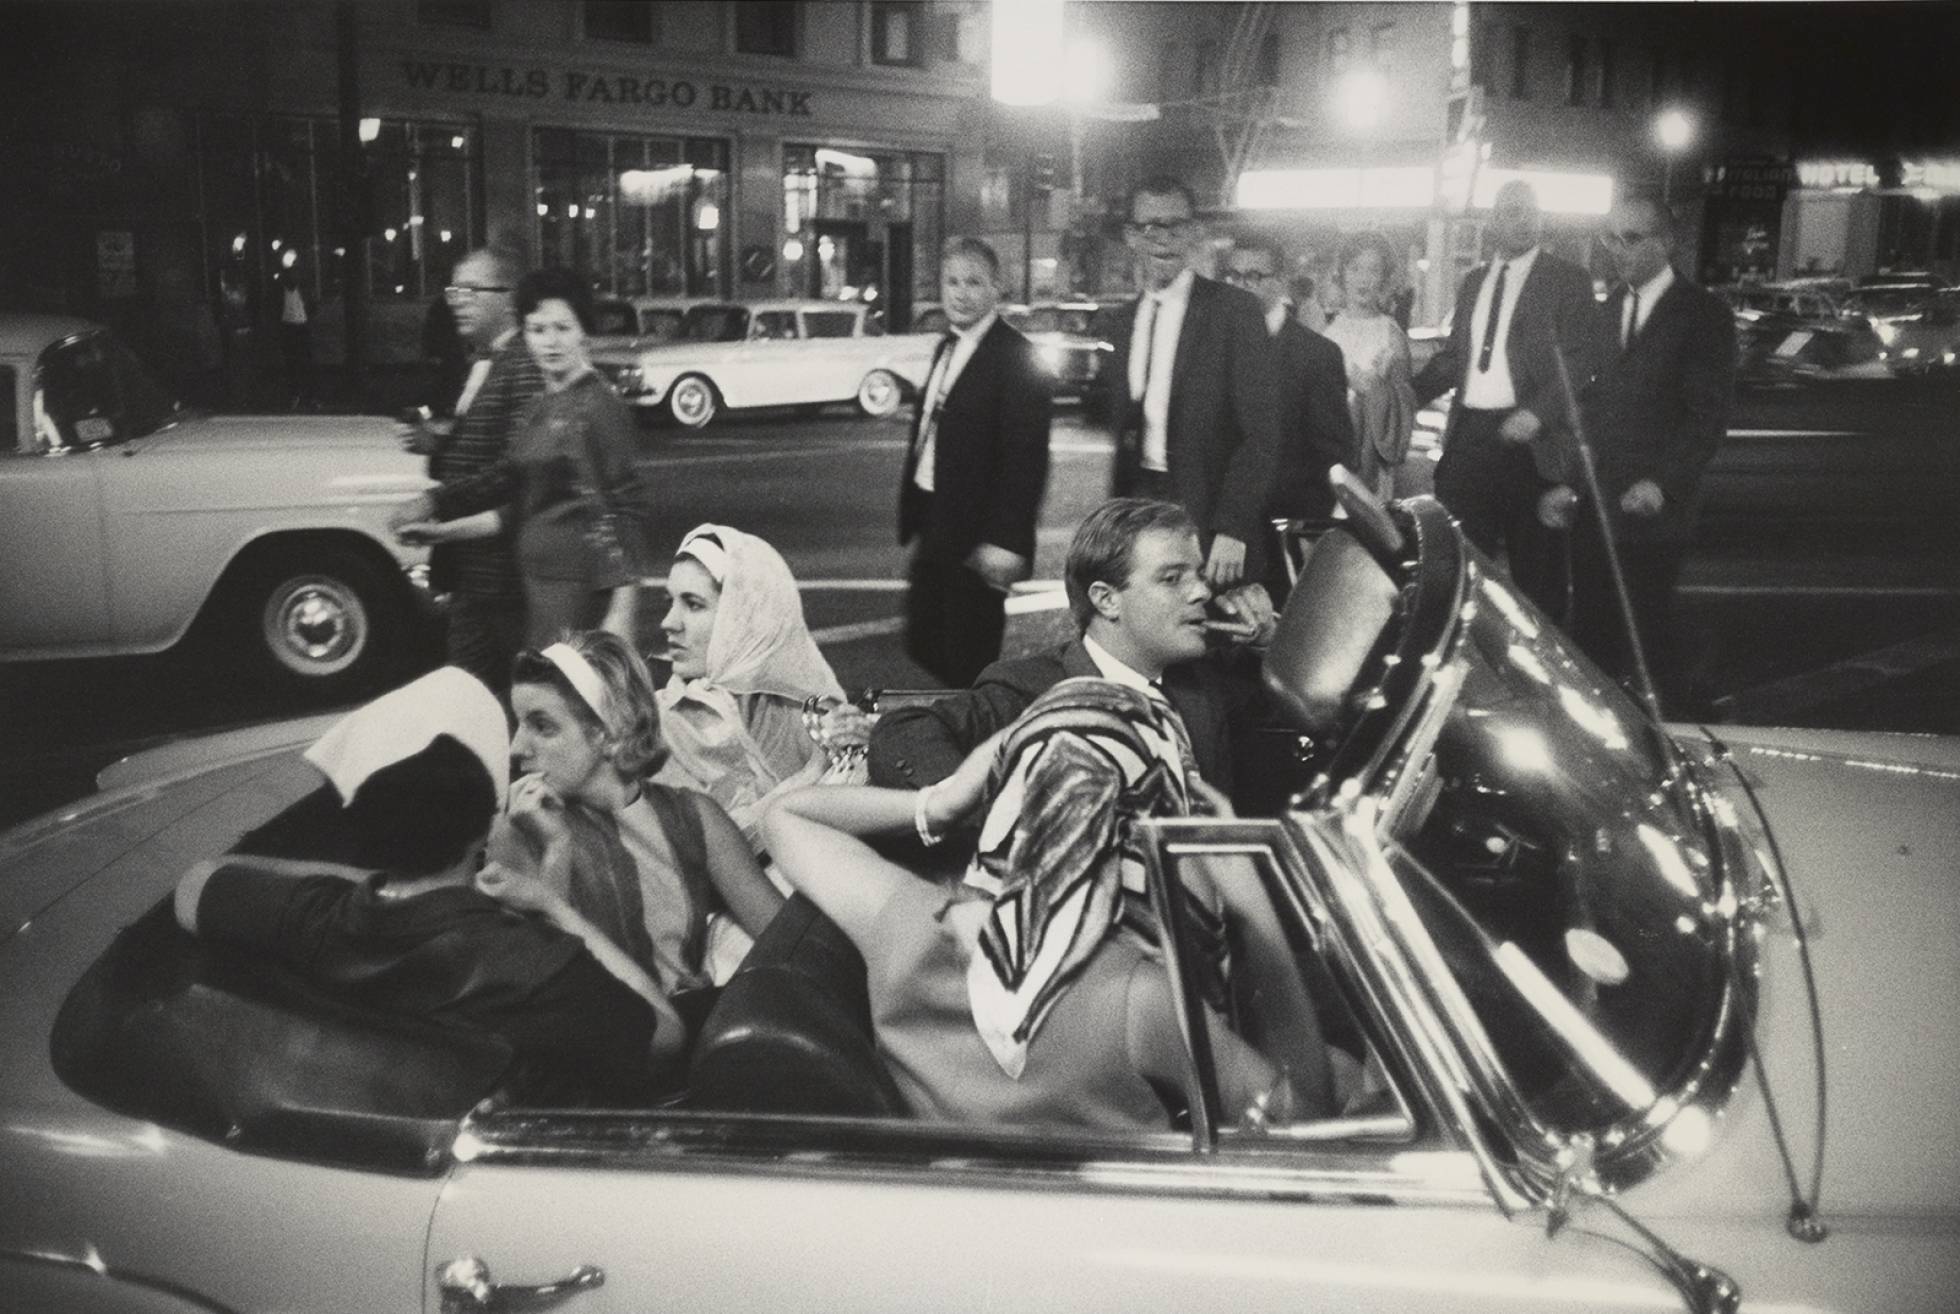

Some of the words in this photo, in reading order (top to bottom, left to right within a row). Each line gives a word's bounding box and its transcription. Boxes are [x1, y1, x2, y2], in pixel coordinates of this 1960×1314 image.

[402, 60, 549, 98] WELLS
[565, 71, 697, 107] FARGO
[709, 84, 813, 116] BANK
